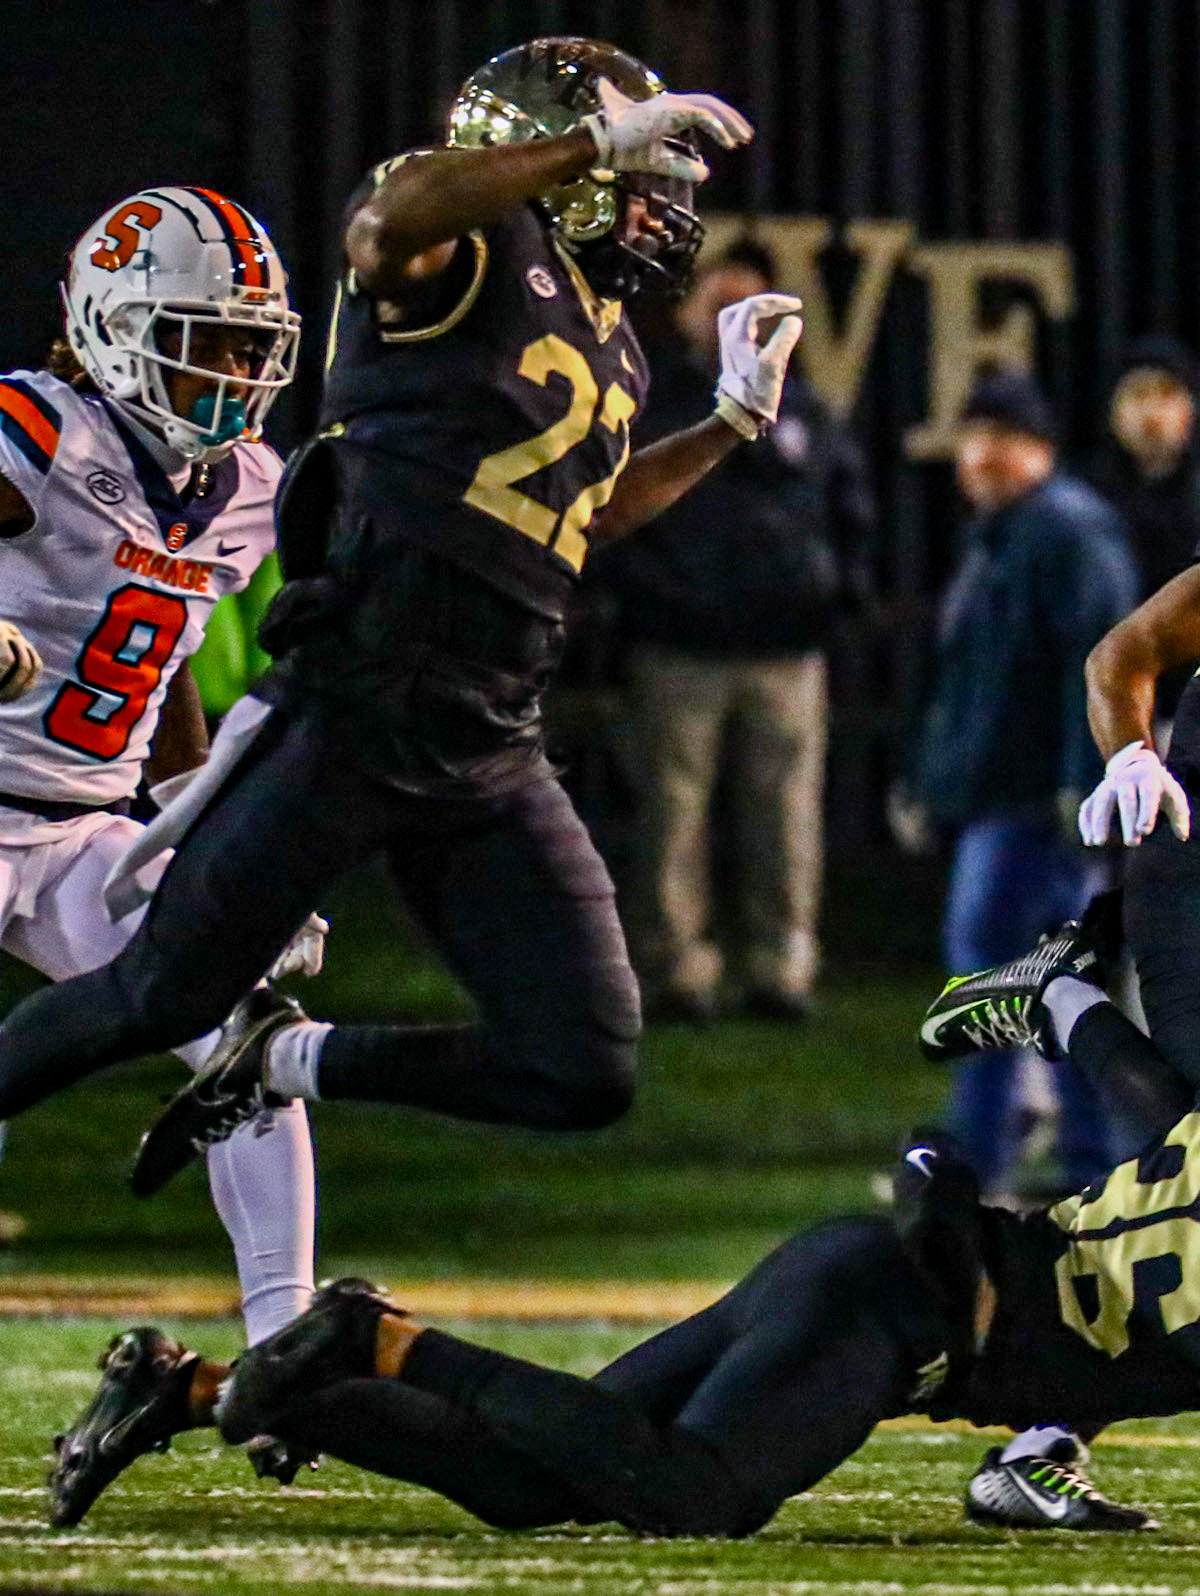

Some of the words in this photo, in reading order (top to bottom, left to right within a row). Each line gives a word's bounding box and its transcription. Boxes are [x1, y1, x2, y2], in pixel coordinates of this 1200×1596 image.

[91, 201, 162, 273] S
[463, 333, 637, 574] 22
[114, 540, 213, 593] ORANGE
[42, 582, 188, 762] 9
